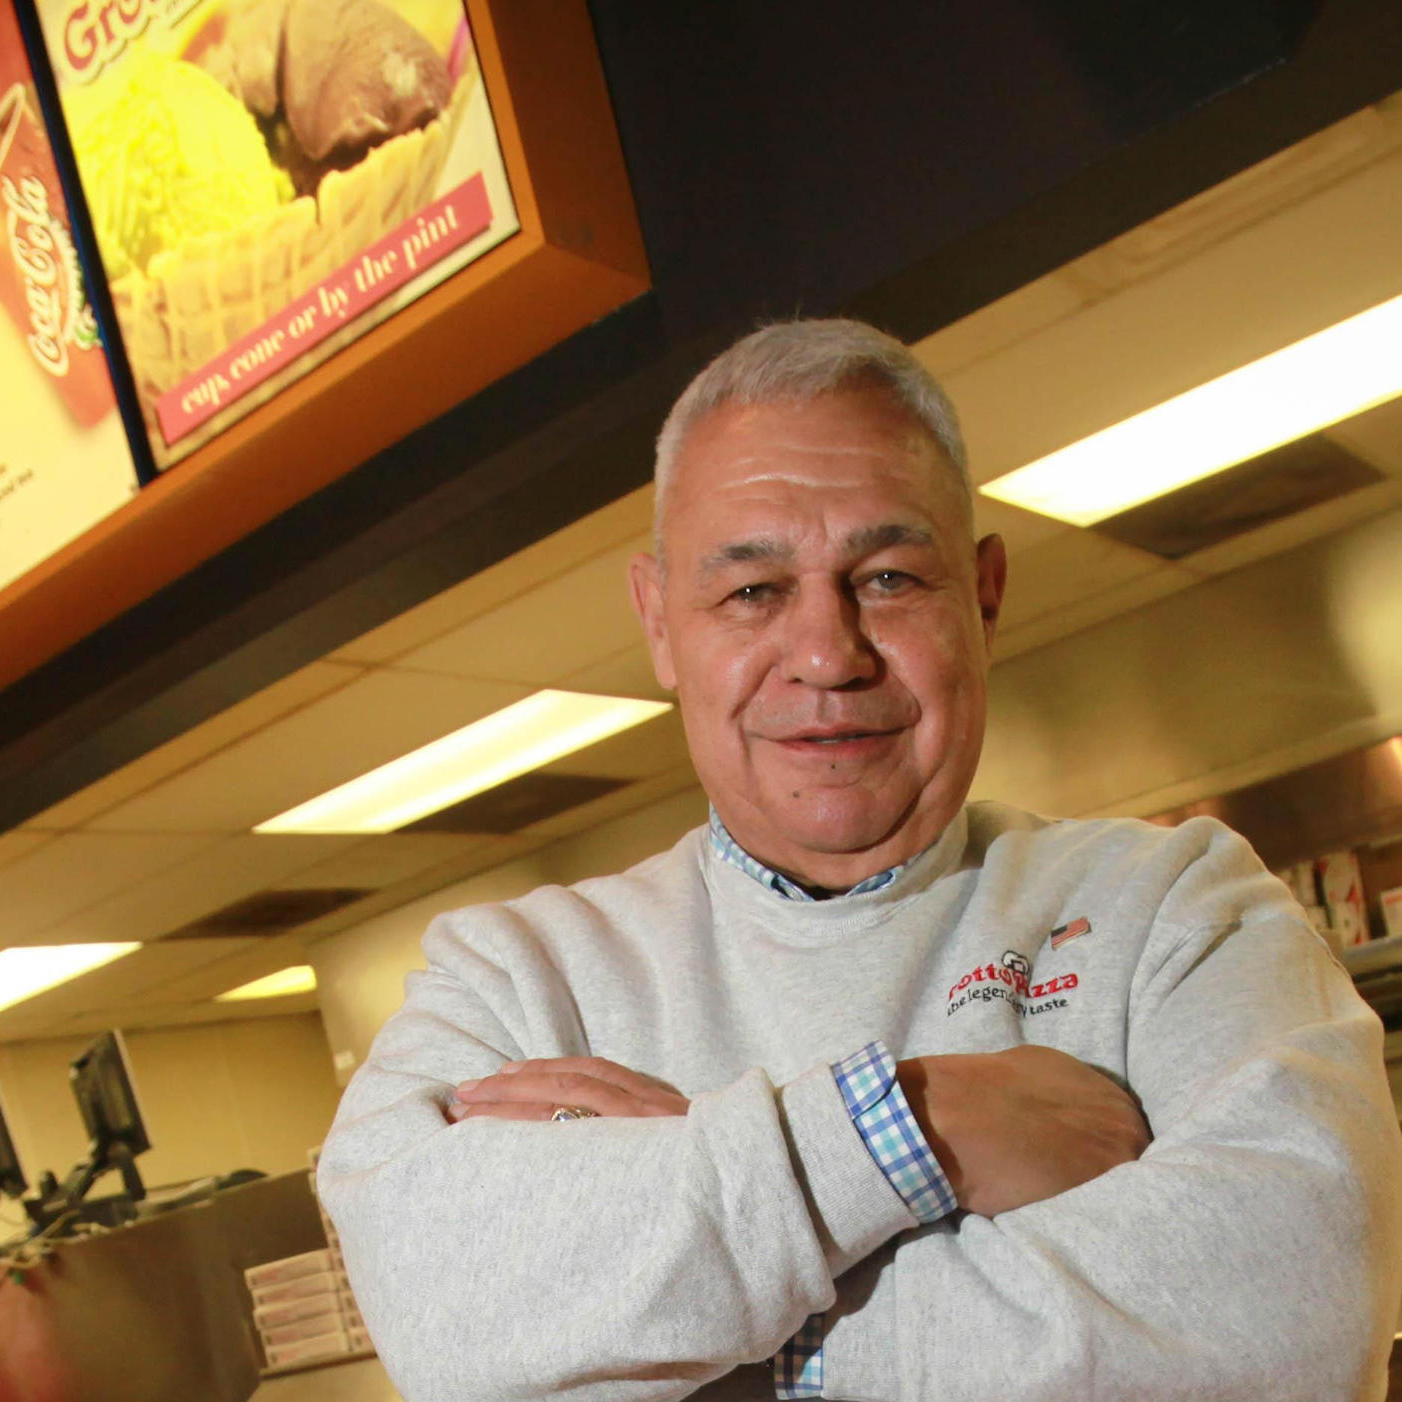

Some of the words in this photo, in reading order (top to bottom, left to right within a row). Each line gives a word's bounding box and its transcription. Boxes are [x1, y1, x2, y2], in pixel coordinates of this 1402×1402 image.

[229, 329, 285, 380] cone
[288, 306, 316, 340] or
[317, 287, 348, 319] by
[353, 250, 397, 293] the
[401, 205, 459, 270] pint
[948, 963, 1014, 1000] rotto
[1029, 997, 1069, 1015] taste
